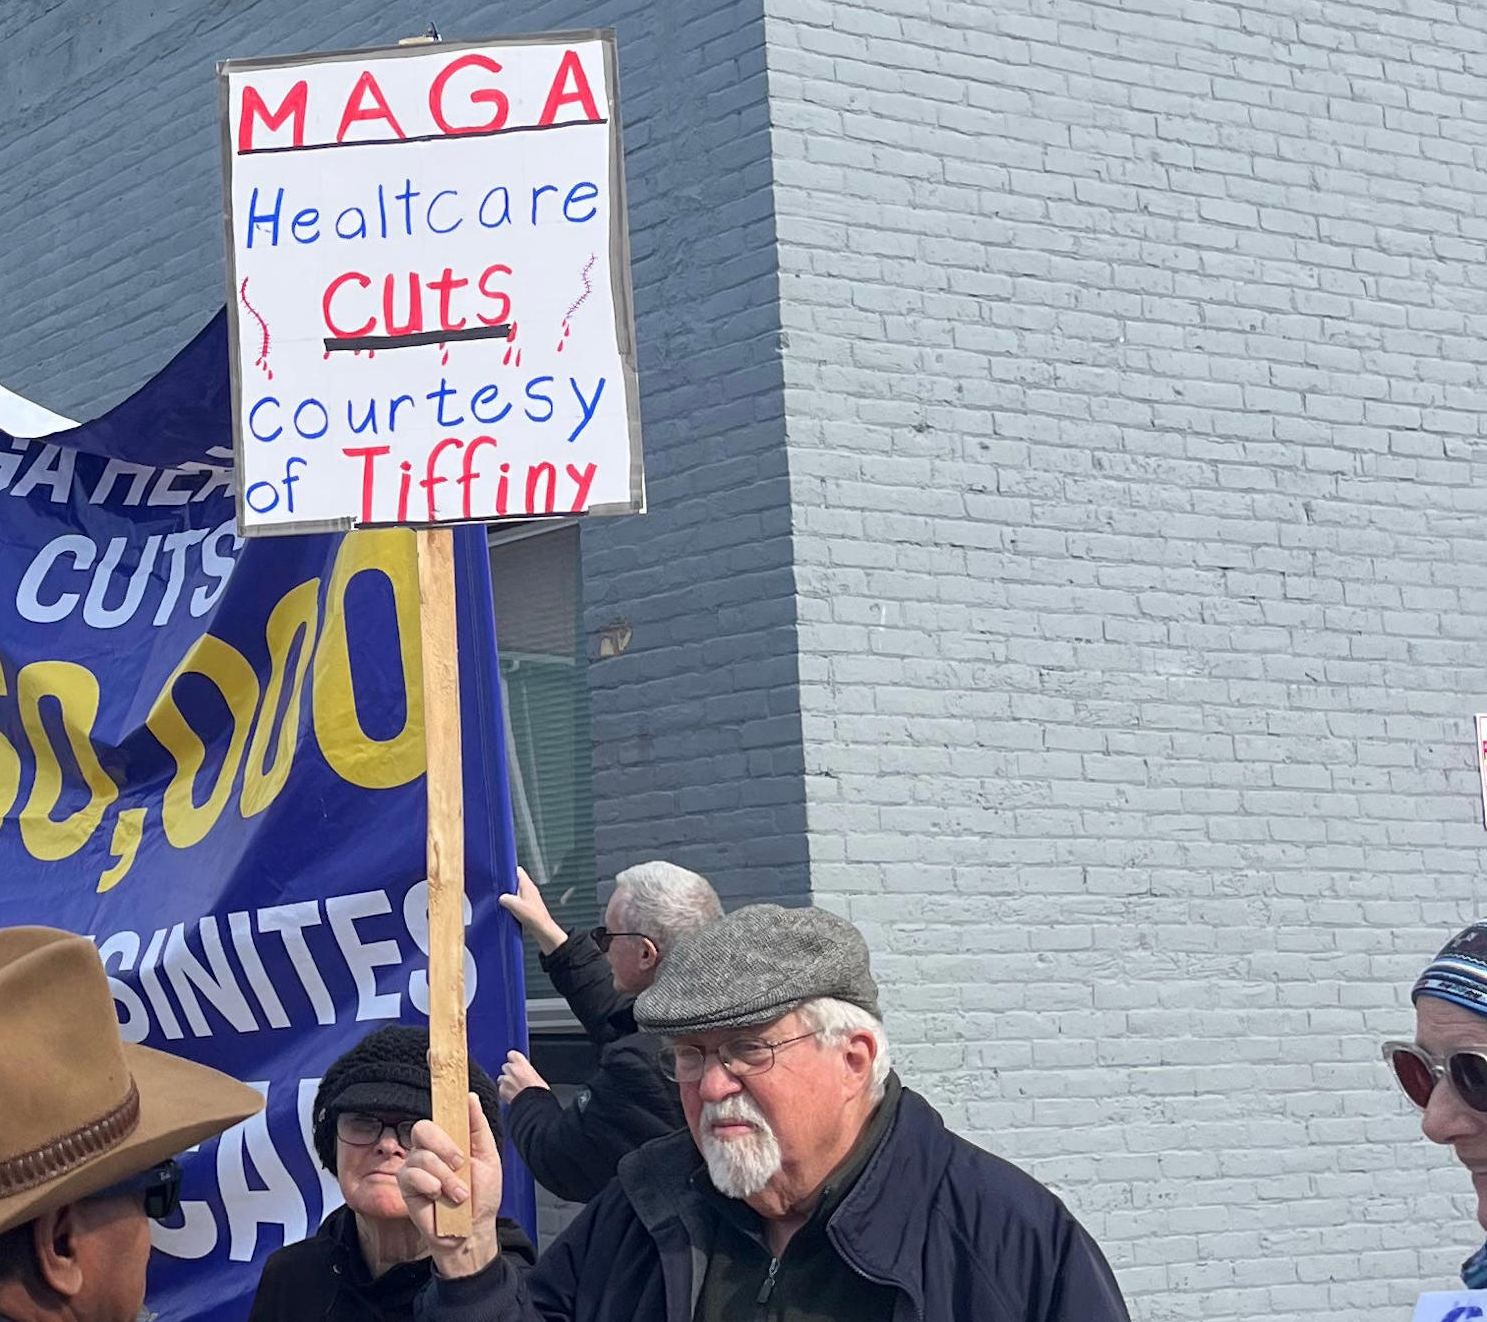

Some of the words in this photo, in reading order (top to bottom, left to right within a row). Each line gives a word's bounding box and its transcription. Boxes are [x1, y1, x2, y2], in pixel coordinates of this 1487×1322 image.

[238, 49, 600, 152] MAGA
[247, 179, 599, 249] Healtcare
[249, 376, 606, 442] courtesy
[246, 457, 307, 513] of
[343, 435, 598, 523] Tiffiny
[16, 516, 245, 630] CUTS
